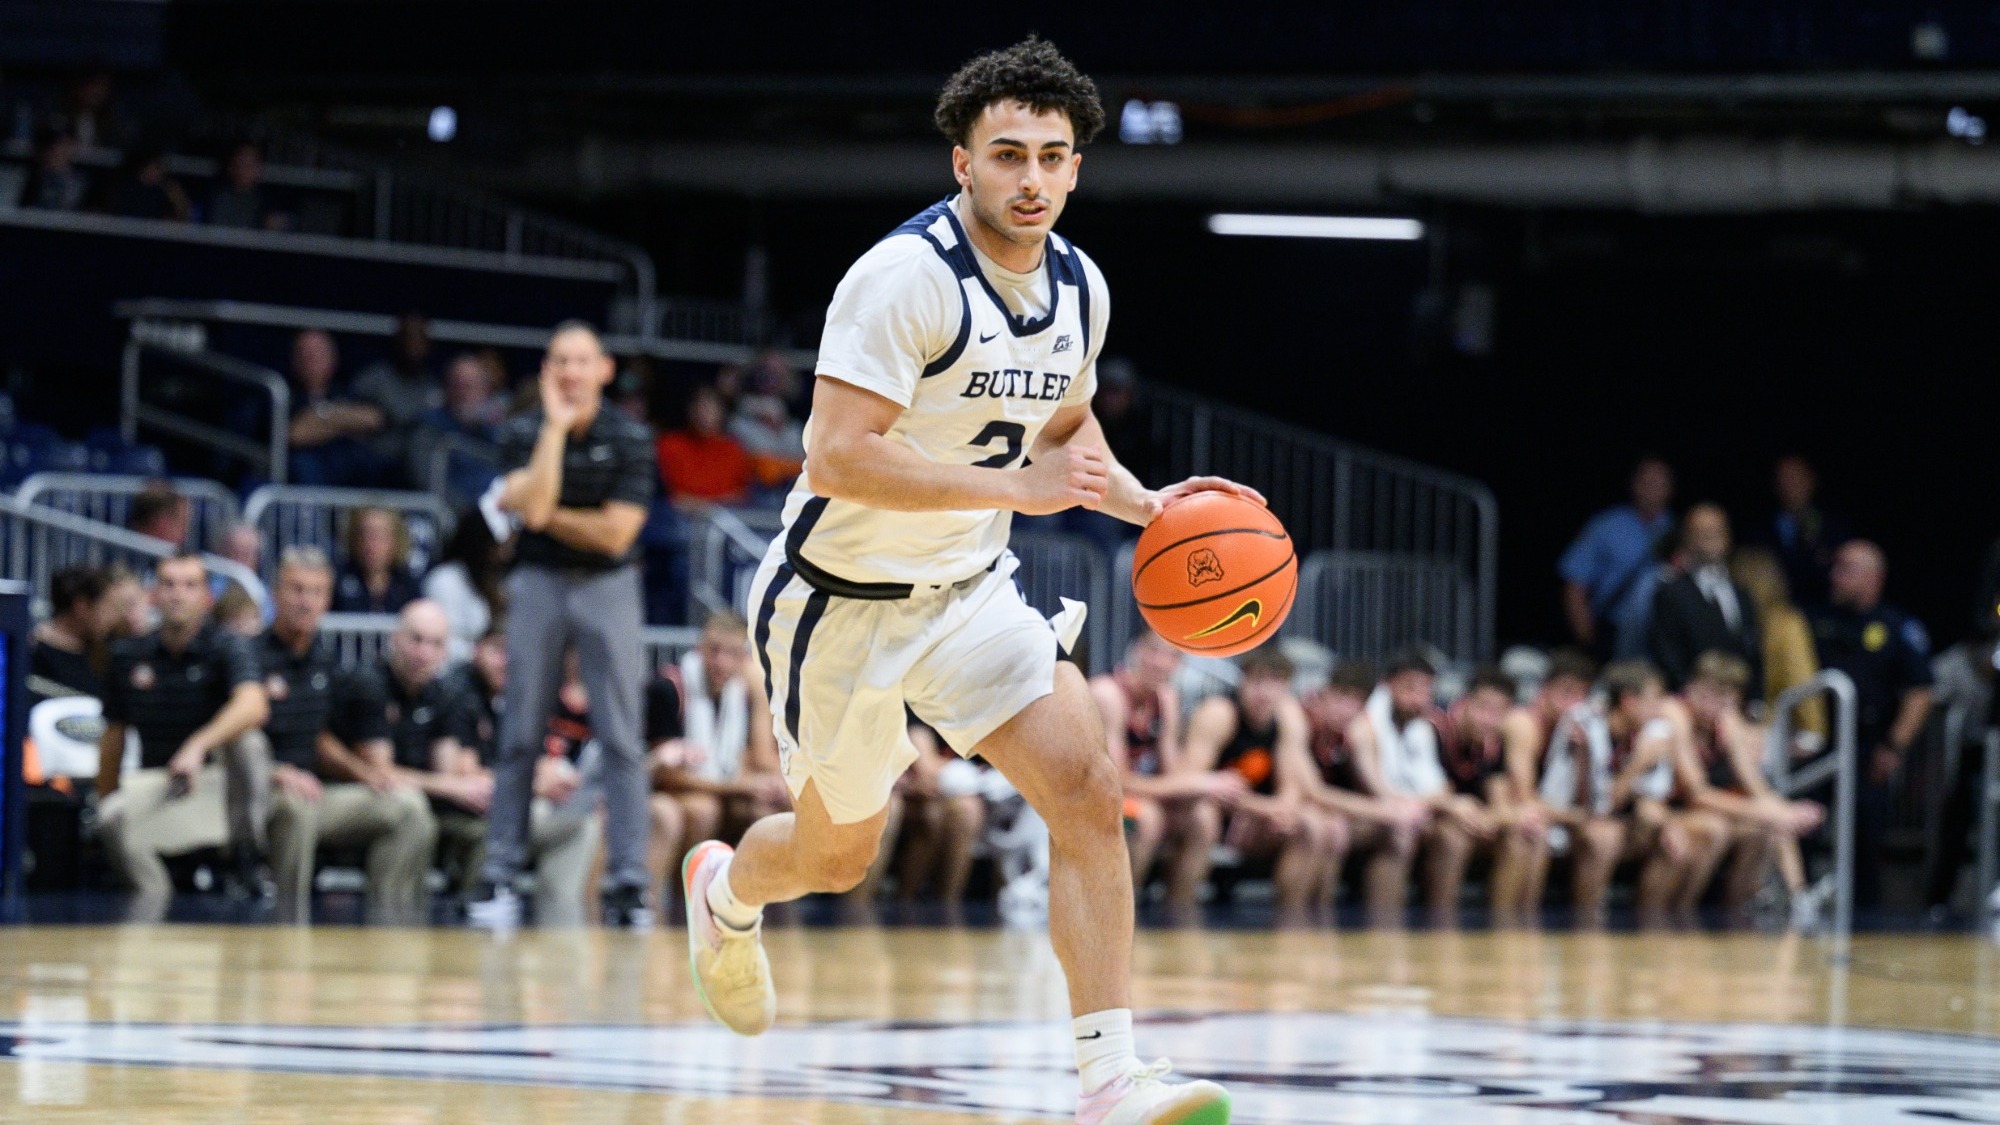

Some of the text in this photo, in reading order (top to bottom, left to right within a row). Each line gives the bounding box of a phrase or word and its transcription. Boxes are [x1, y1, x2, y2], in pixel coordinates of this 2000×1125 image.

[1056, 335, 1071, 343] BIG
[1053, 341, 1074, 351] EAST
[960, 369, 1071, 401] BUTLER
